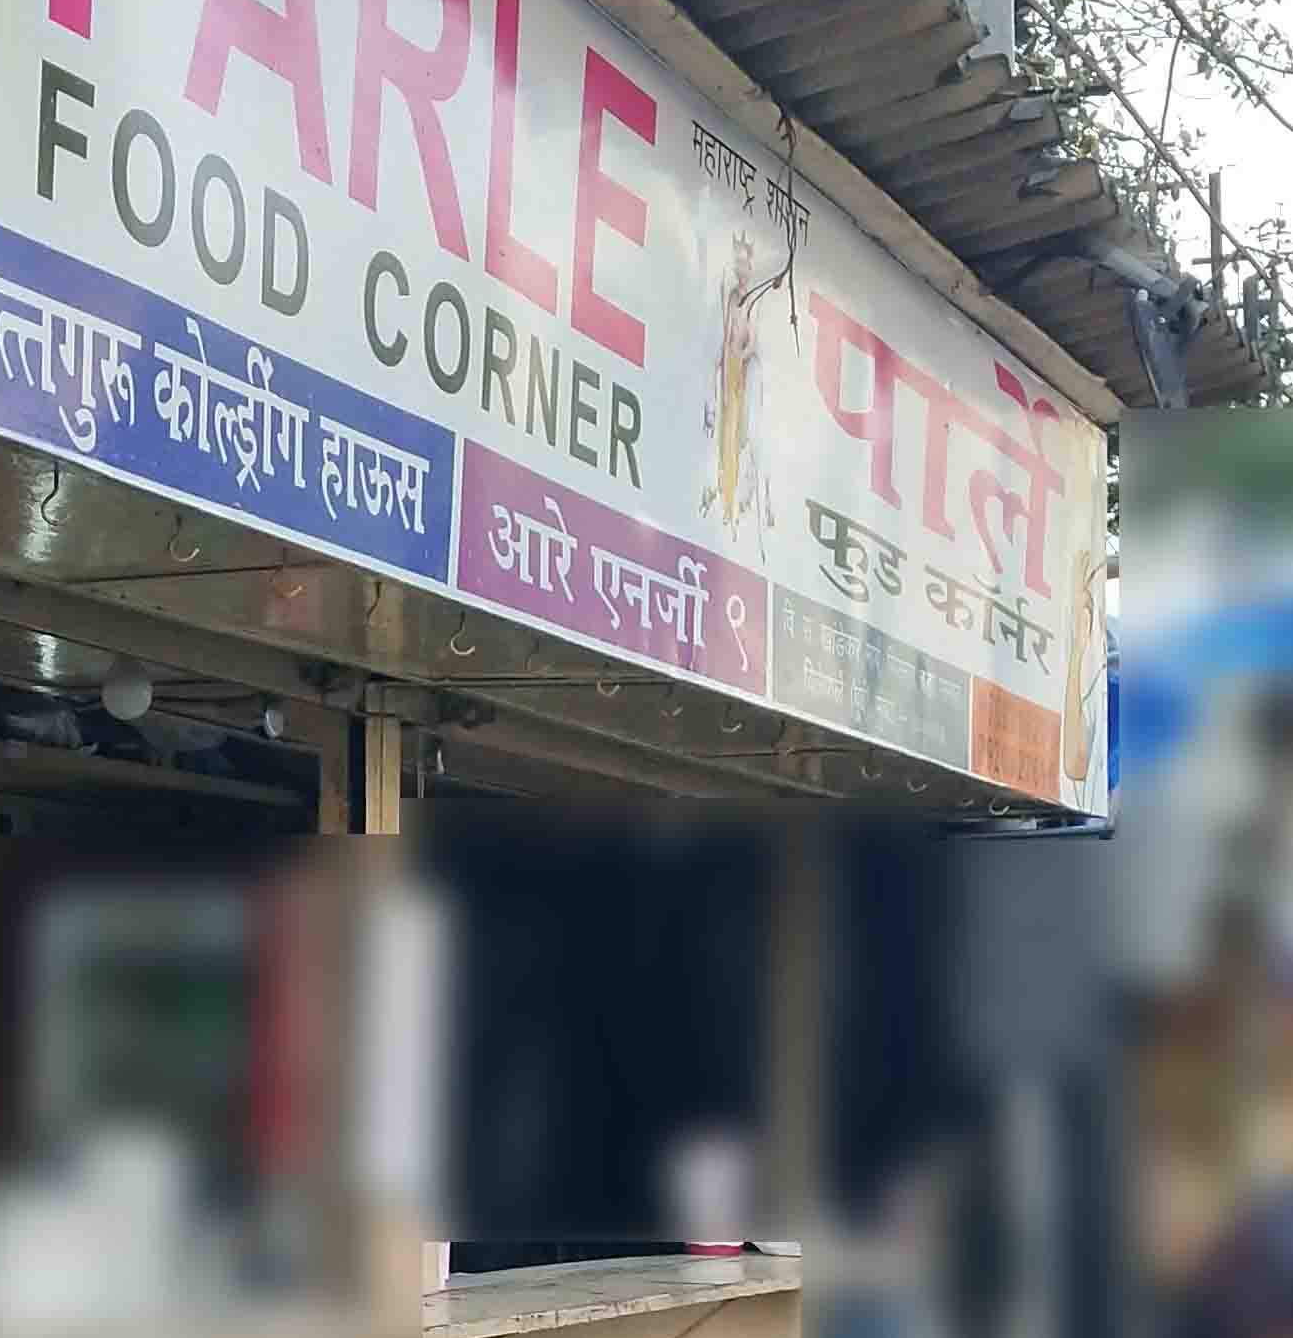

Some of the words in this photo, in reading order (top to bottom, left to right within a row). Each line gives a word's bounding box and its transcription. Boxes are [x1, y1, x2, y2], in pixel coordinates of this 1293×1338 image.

[691, 119, 757, 214] महाराष्ट्र
[766, 177, 811, 247] शासन
[36, 58, 307, 318] FOOD
[362, 250, 644, 490] CORNER
[319, 414, 430, 535] हाऊस
[488, 496, 578, 603] आरे
[590, 544, 709, 648] एनर्जी
[805, 497, 907, 603] फुड
[924, 564, 1054, 676] कॉर्नर
